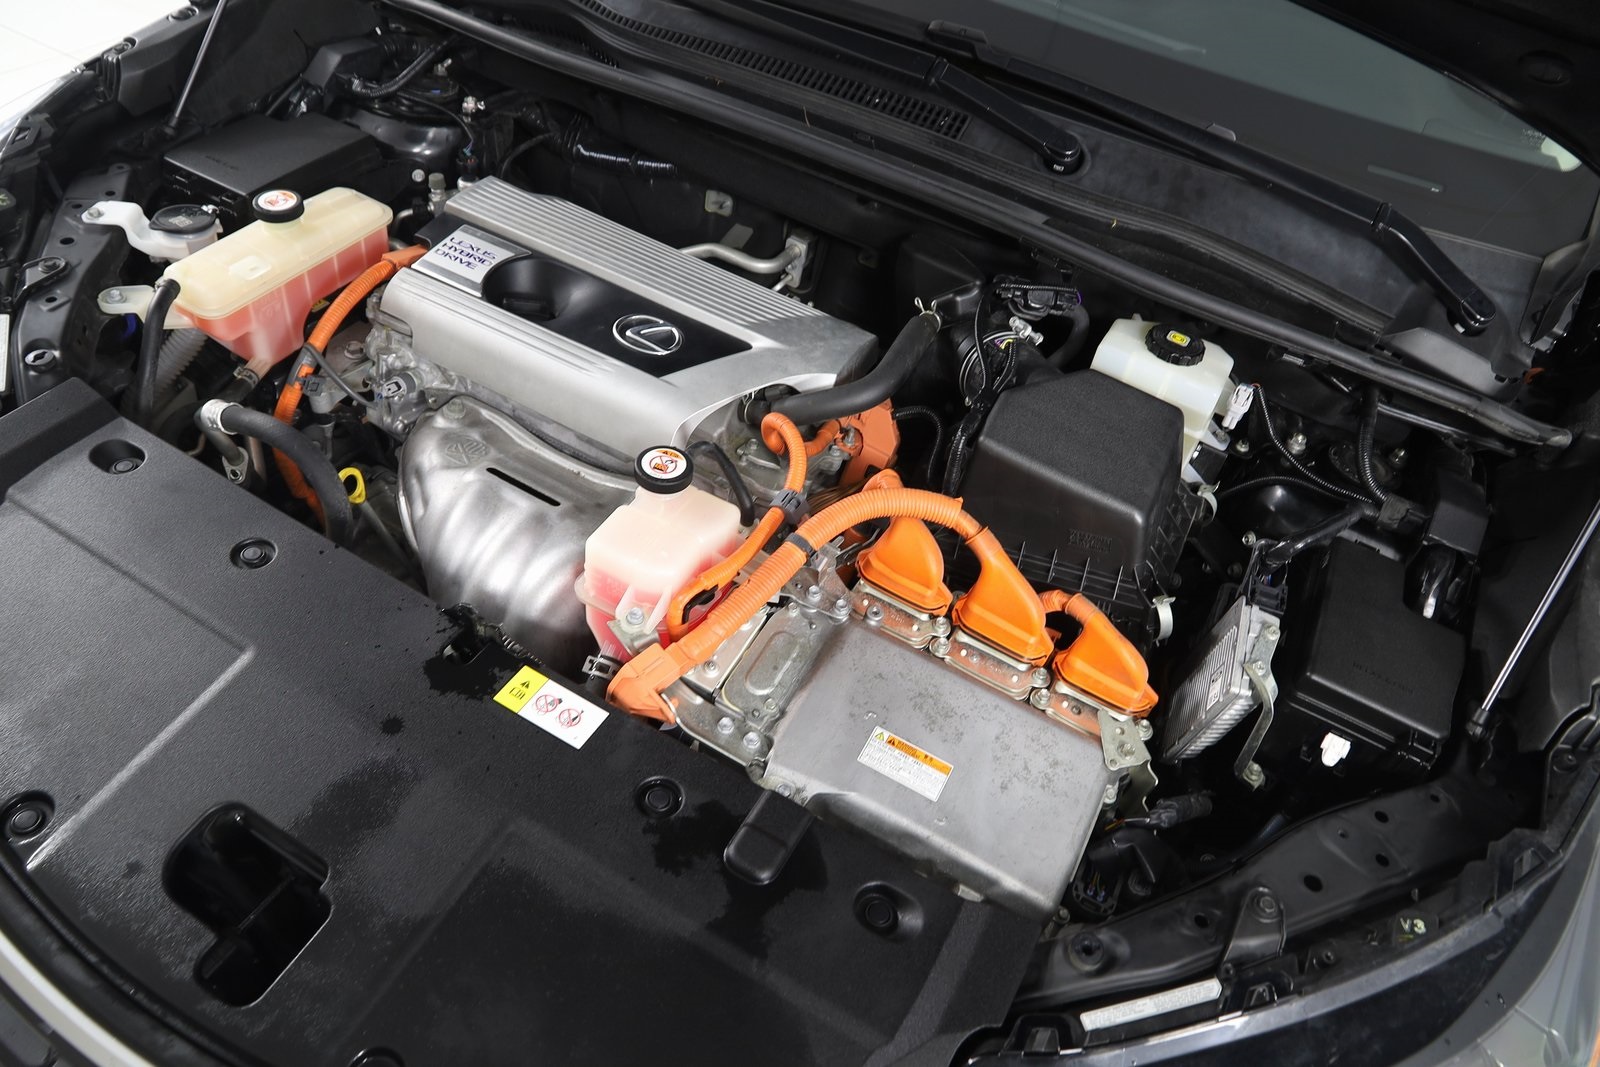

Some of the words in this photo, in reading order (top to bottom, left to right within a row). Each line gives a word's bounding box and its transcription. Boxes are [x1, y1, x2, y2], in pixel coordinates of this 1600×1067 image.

[435, 249, 478, 269] DRIVE
[442, 243, 493, 267] HYBRID
[450, 237, 496, 259] LEXUS
